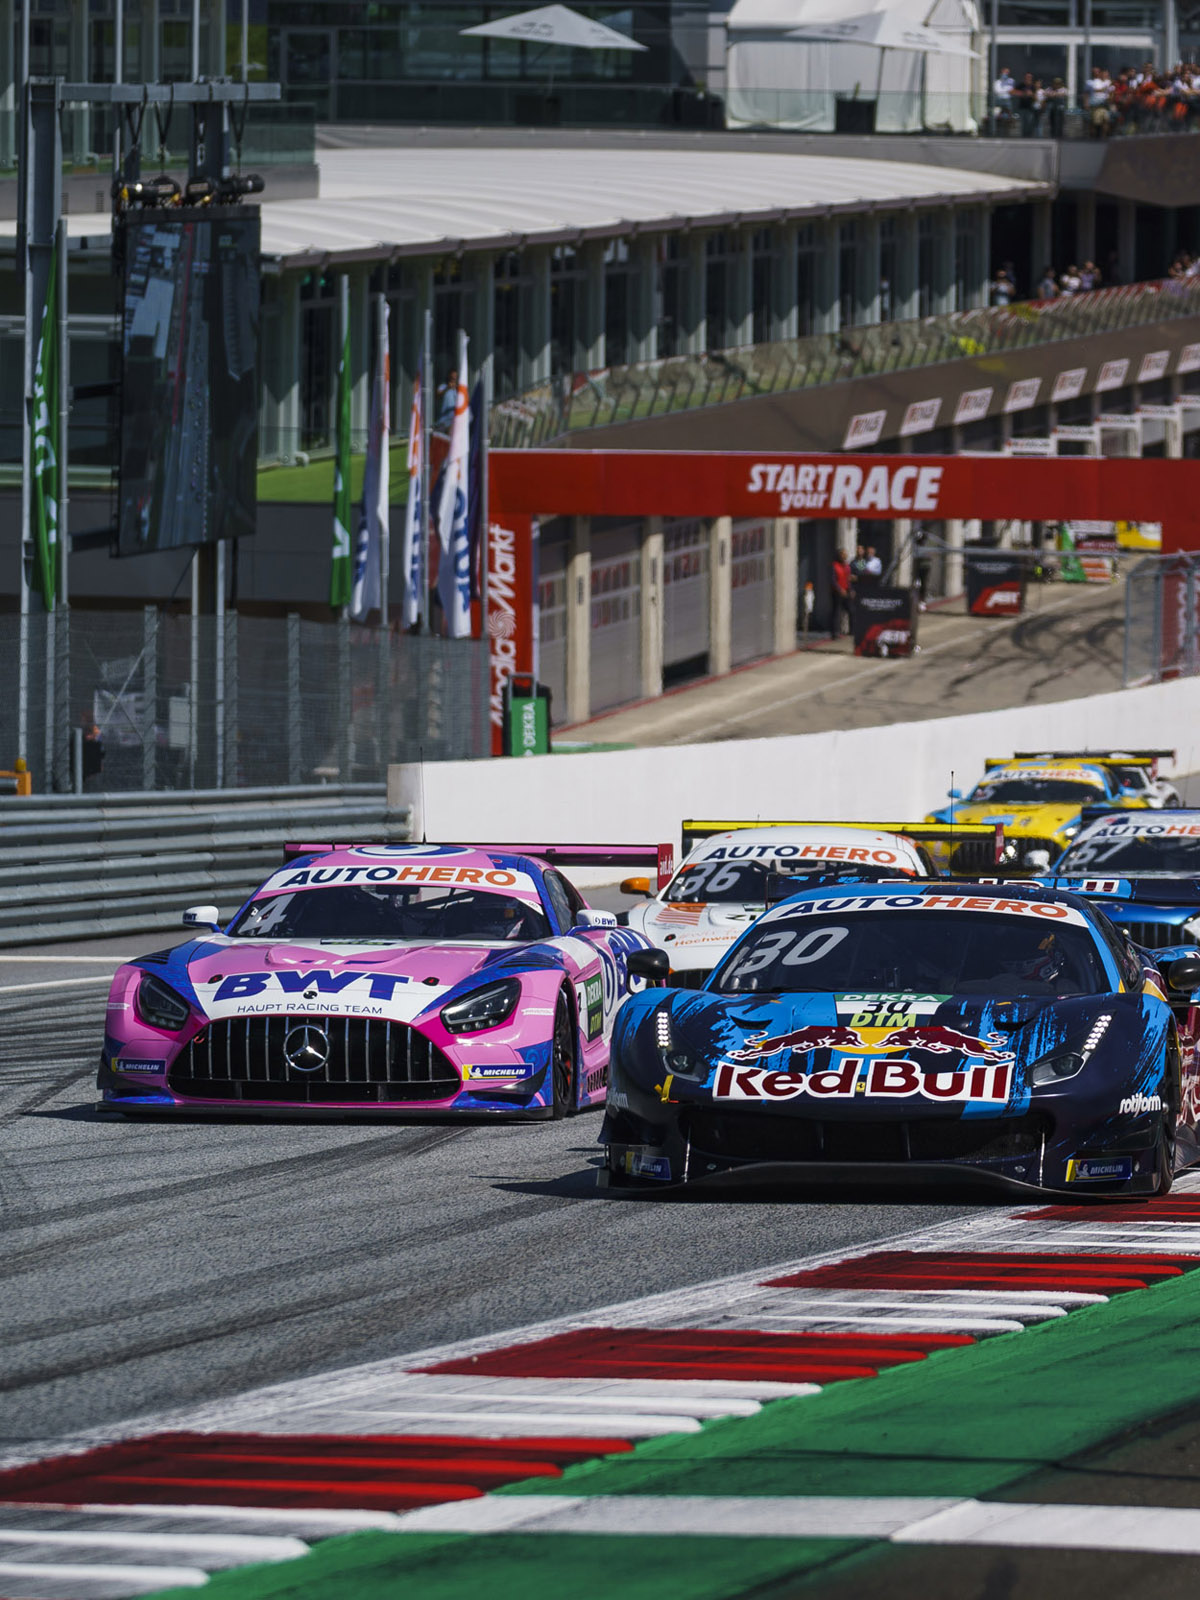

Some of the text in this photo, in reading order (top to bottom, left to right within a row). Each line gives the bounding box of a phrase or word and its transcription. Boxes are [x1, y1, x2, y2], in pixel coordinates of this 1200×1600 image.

[747, 463, 833, 493] START
[829, 464, 944, 511] RACE
[780, 491, 828, 513] your
[488, 523, 516, 616] Markt
[522, 702, 536, 747] DEKRA
[991, 769, 1093, 779] AUTOHERO
[702, 844, 897, 864] AUTOHERO
[279, 866, 517, 888] AUTOHERO
[669, 860, 752, 897] 36
[237, 892, 297, 935] 4
[779, 895, 1069, 919] AUTOHERO
[732, 925, 850, 977] 30
[213, 969, 410, 1002] BWT
[586, 977, 603, 1008] DEKRA
[237, 1003, 383, 1014] HAUPT RACING TEAM
[842, 994, 940, 1002] DEKRA
[861, 1001, 913, 1015] 30
[850, 1012, 917, 1028] DTM
[125, 1063, 160, 1071] MICHELIN
[483, 1068, 526, 1076] MICHELIN
[714, 1058, 1014, 1102] Red Bull
[1118, 1091, 1162, 1118] rotiform
[1089, 1164, 1124, 1175] MICHELIN
